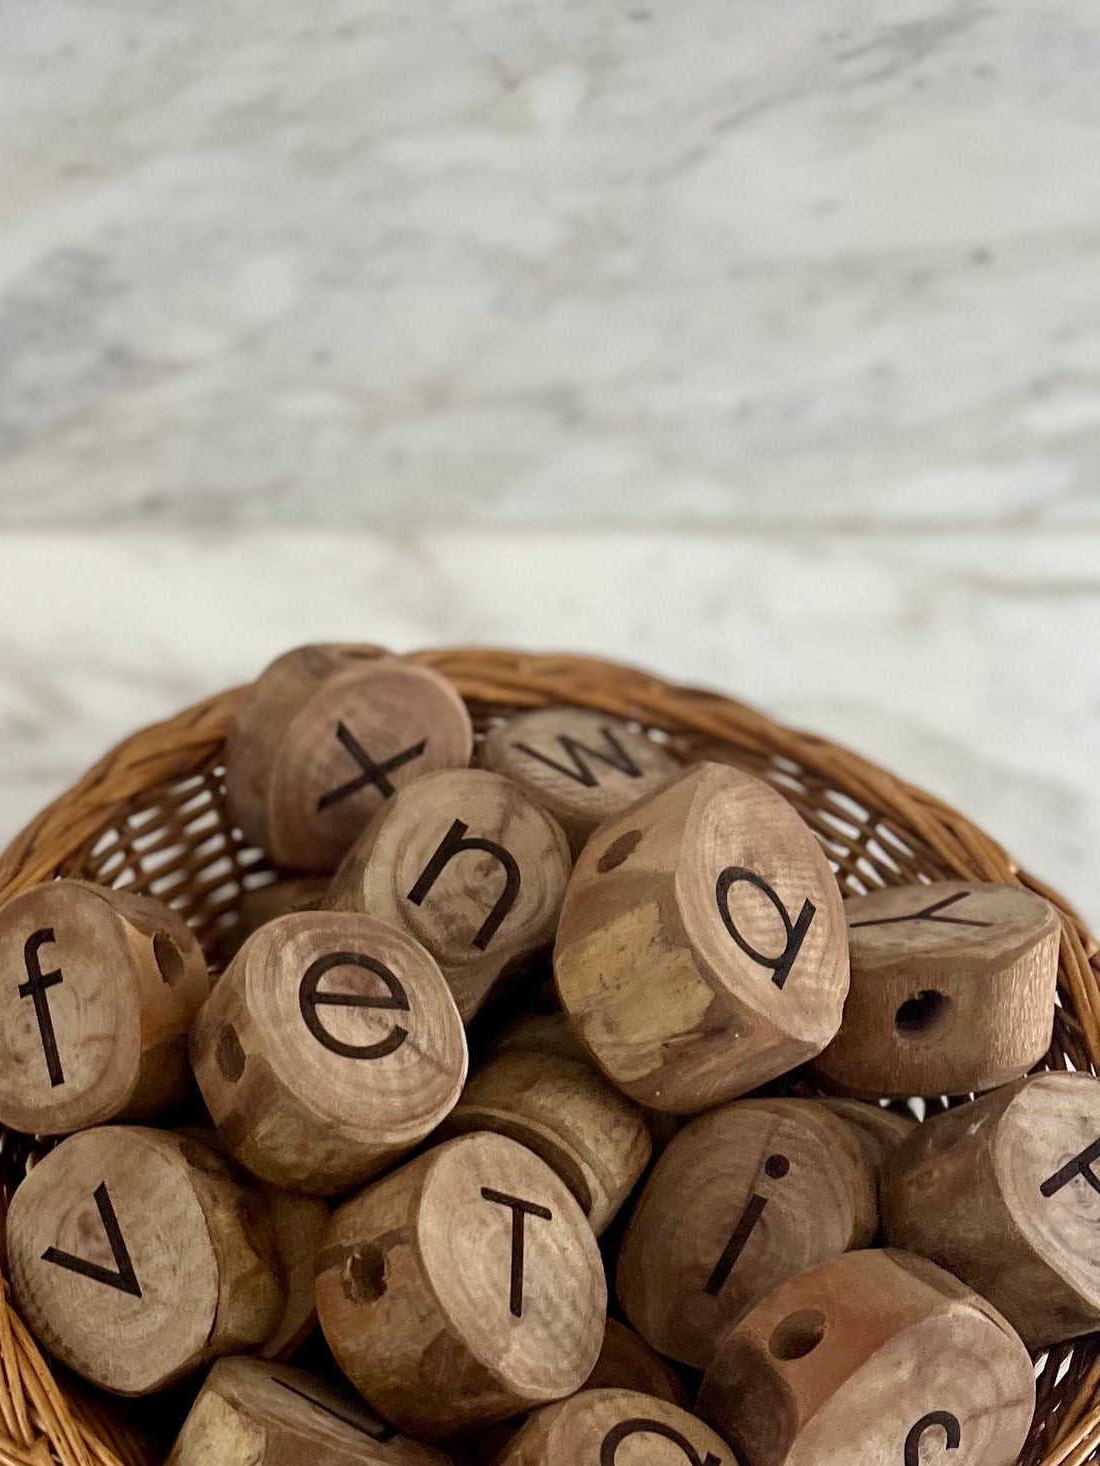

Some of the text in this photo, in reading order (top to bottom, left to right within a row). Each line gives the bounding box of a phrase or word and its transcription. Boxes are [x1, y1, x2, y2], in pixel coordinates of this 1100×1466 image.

[407, 819, 521, 952] n
[18, 927, 64, 1088] f
[299, 950, 410, 1060] e
[480, 1186, 552, 1318] T
[706, 1154, 790, 1296] i
